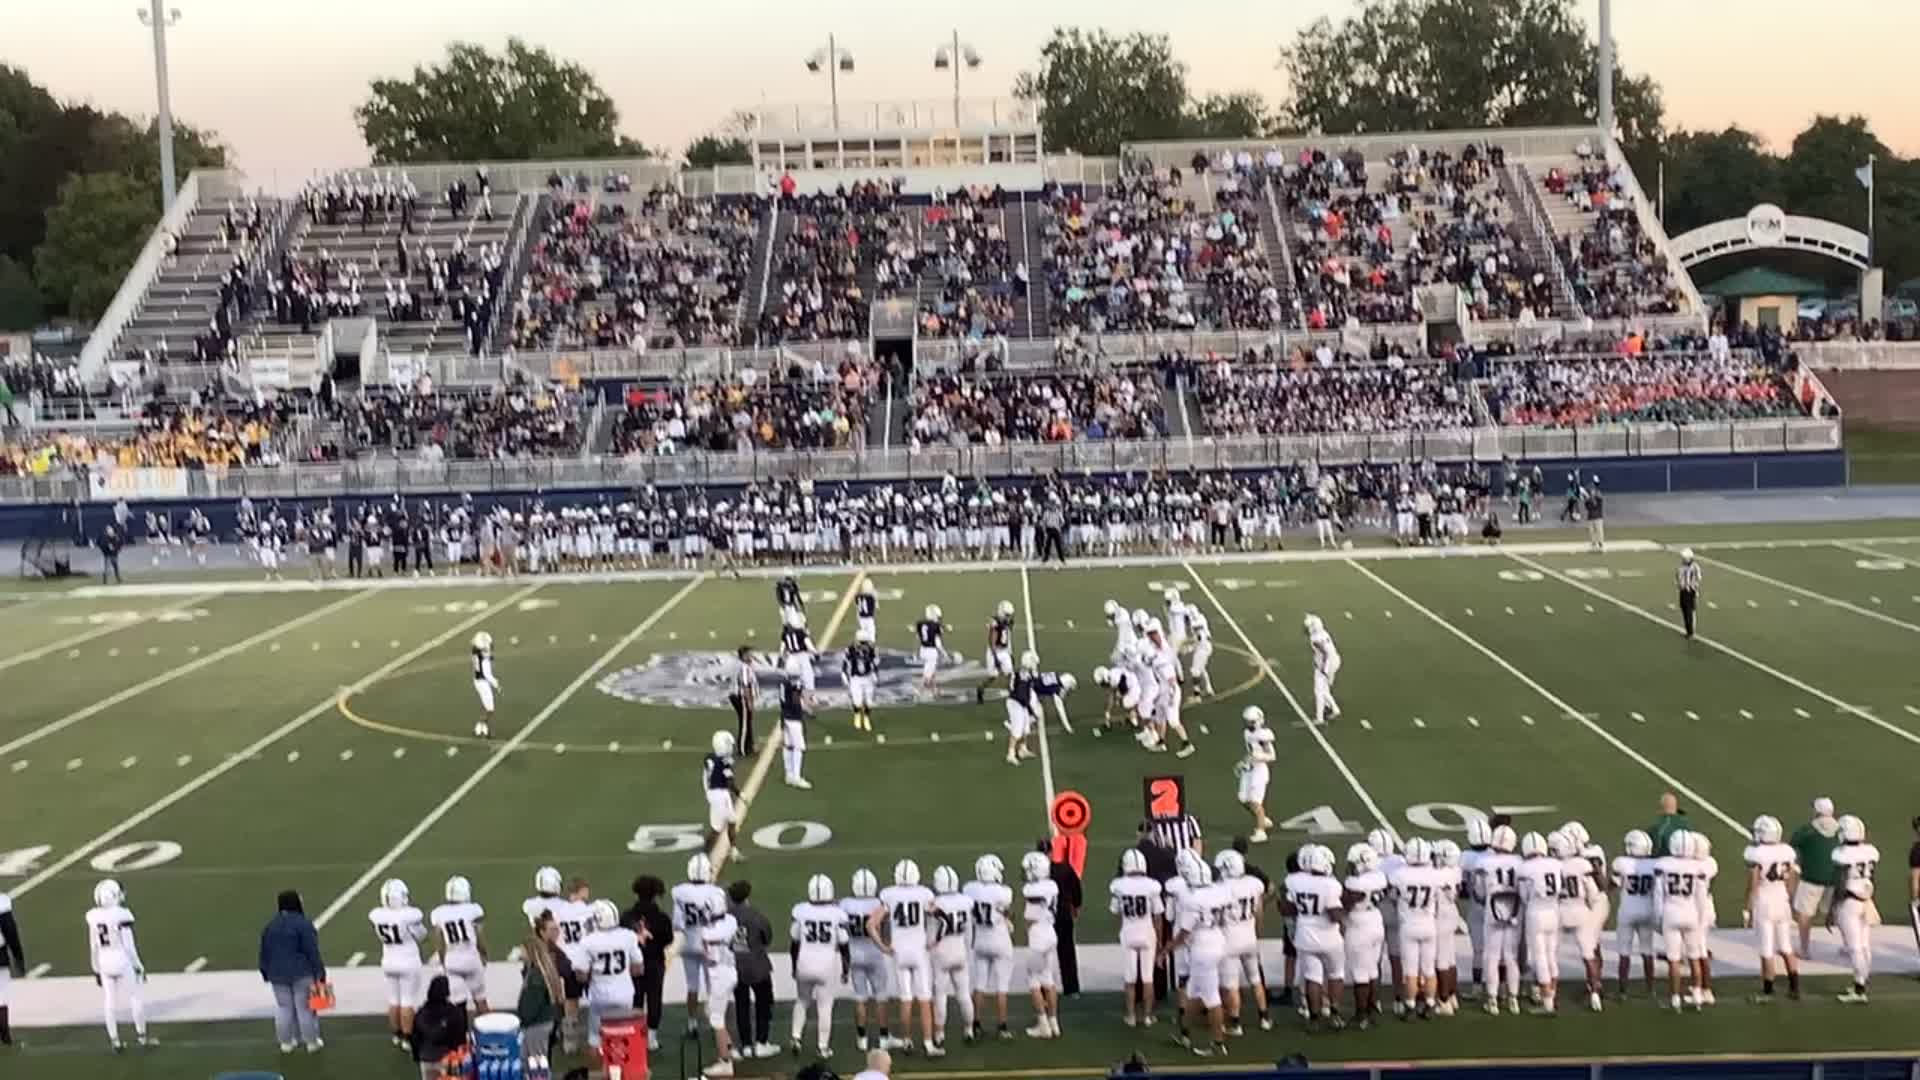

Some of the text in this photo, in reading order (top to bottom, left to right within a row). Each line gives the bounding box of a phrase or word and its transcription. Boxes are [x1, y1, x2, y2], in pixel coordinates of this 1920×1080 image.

[1150, 779, 1180, 819] 2
[1496, 867, 1516, 887] 11
[1667, 872, 1694, 897] 23
[1296, 892, 1319, 916] 57
[1407, 885, 1431, 909] 77
[894, 901, 920, 927] 40
[97, 923, 110, 947] 2
[378, 923, 403, 945] 51
[445, 918, 471, 945] 81
[804, 920, 832, 944] 35
[597, 950, 626, 976] 73
